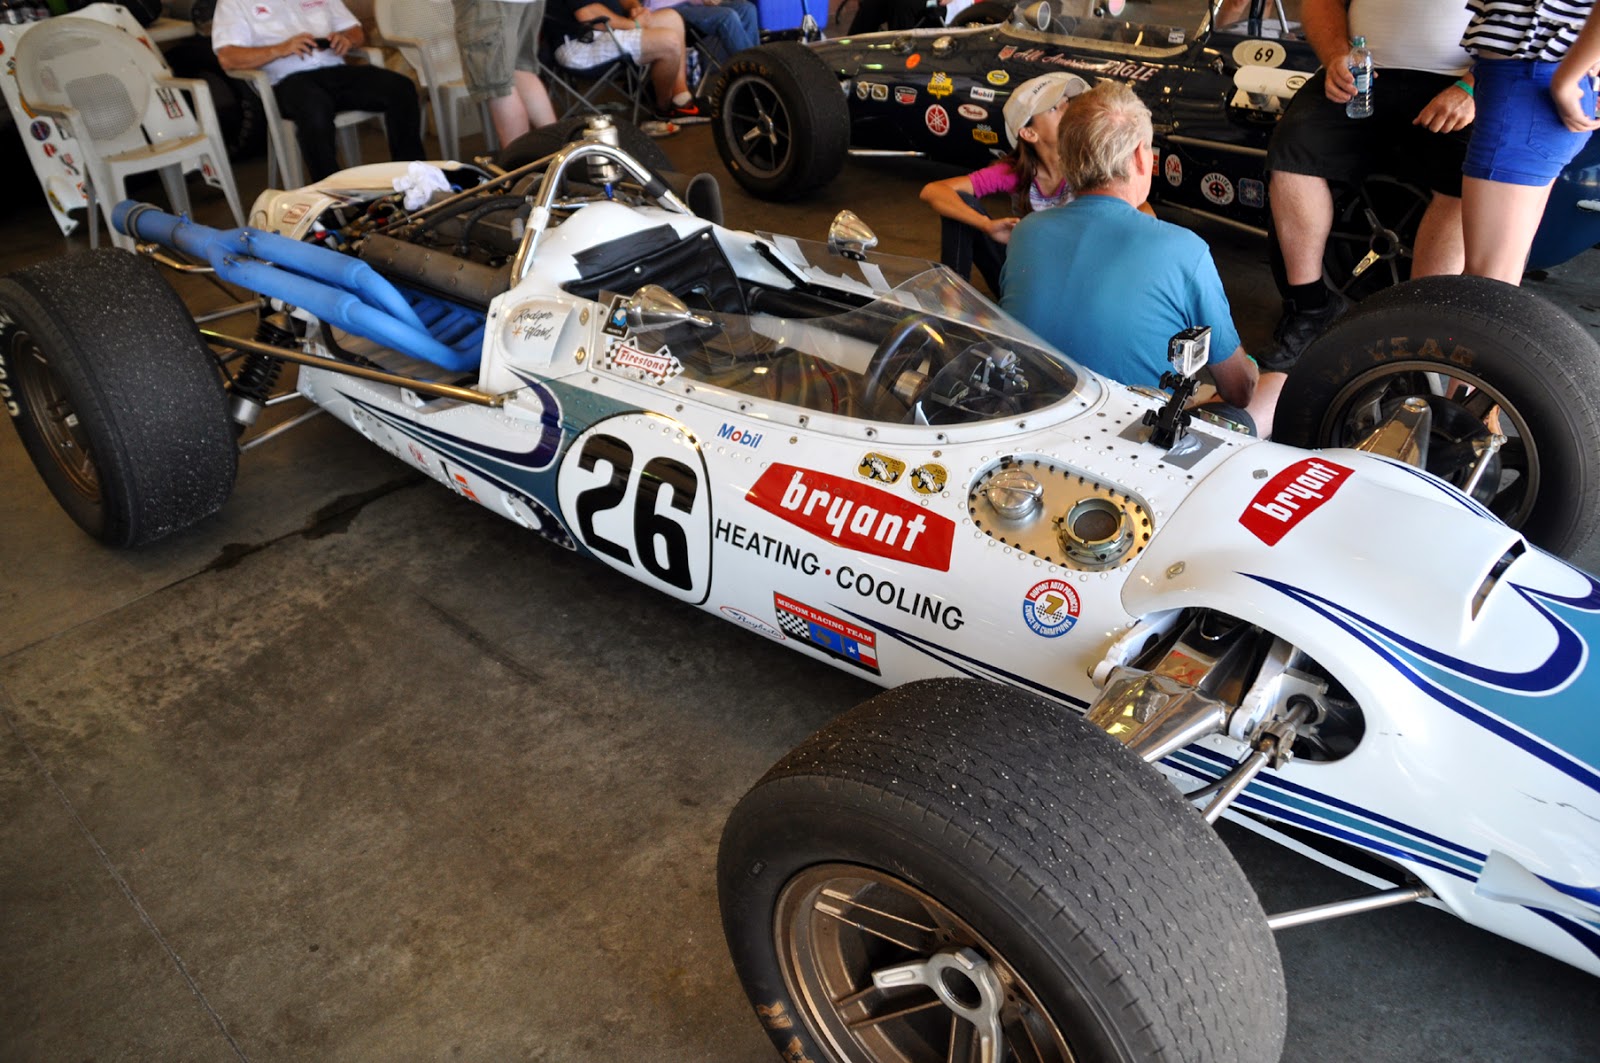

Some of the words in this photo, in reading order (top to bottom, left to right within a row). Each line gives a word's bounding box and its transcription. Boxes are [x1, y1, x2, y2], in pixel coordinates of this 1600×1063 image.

[1254, 47, 1274, 63] 69
[972, 89, 993, 99] Mobil
[619, 350, 666, 371] Firestone
[717, 423, 763, 448] Mobil
[1252, 461, 1340, 523] bryant
[576, 433, 698, 591] 26
[779, 470, 927, 551] bryant
[714, 518, 820, 575] HEATING
[836, 566, 965, 631] COOLING
[1045, 594, 1065, 615] 7
[777, 598, 809, 615] MECOM
[810, 611, 844, 631] RACING
[845, 626, 873, 643] TEAM
[1032, 623, 1041, 631] OF
[1040, 619, 1073, 635] CHAMPIONS
